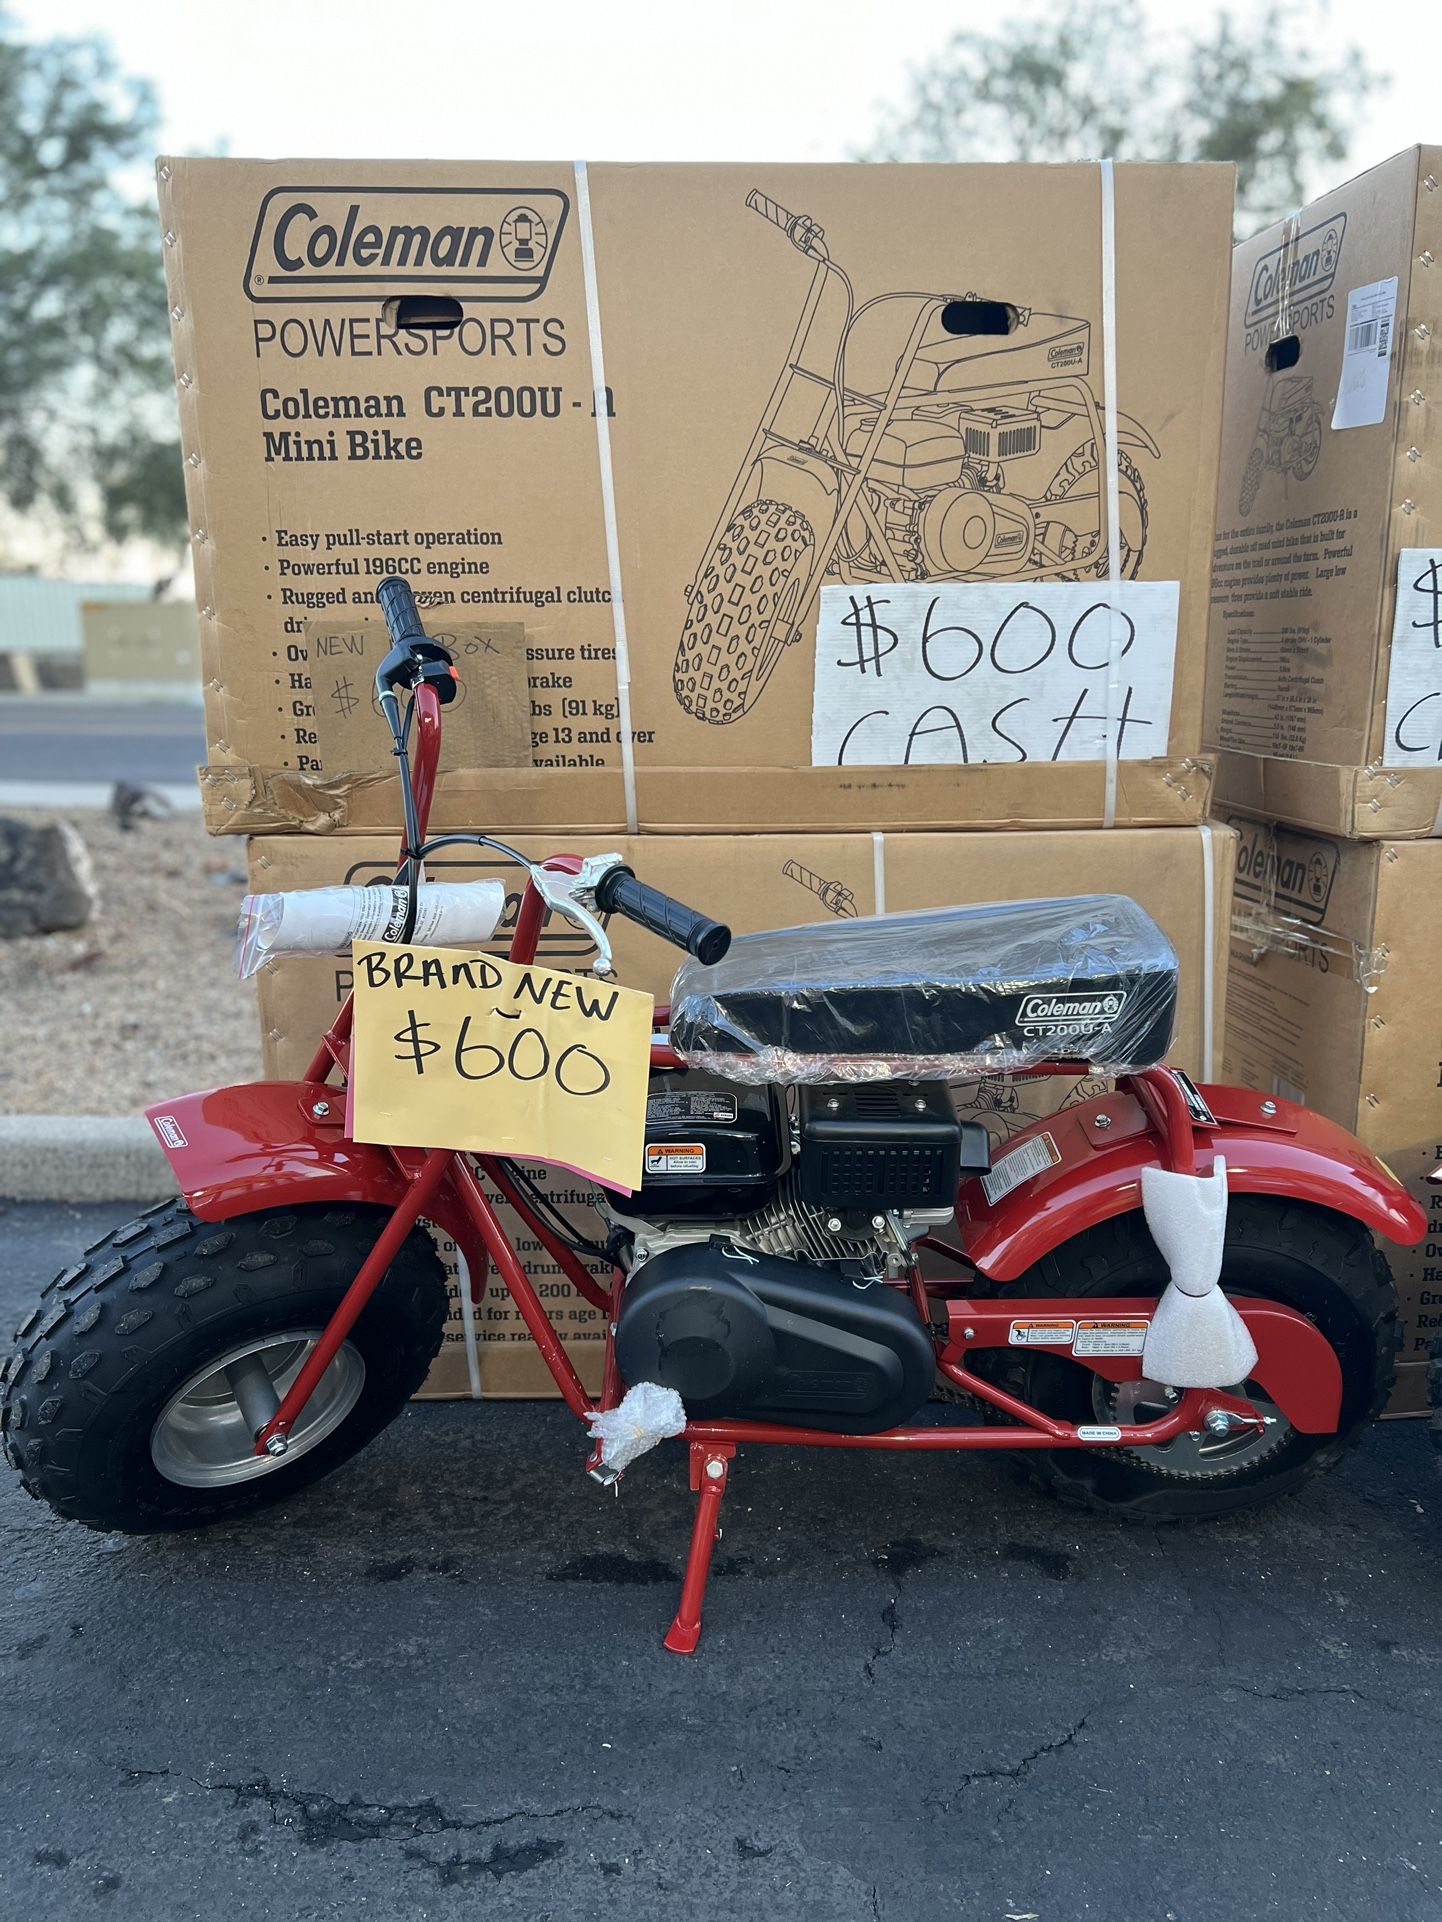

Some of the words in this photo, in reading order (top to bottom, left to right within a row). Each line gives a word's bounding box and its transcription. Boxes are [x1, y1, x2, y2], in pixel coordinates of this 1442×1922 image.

[273, 203, 494, 272] Coleman
[1254, 249, 1320, 306] Coleman
[1051, 346, 1077, 358] Coleman
[260, 387, 406, 420] Coleman
[423, 385, 563, 418] CT200U
[262, 430, 338, 462] Mini
[346, 429, 423, 461] Bike
[275, 529, 320, 550] Easy
[325, 528, 410, 550] pull-start
[414, 528, 503, 549] operation
[278, 557, 360, 576] Powerful
[364, 557, 421, 575] 196CC
[426, 557, 490, 578] engine
[281, 587, 347, 608] Rugged
[460, 586, 562, 607] centrifugal
[566, 586, 614, 604] clutc
[316, 635, 364, 658] NEW
[836, 595, 1136, 682] $600
[553, 727, 573, 744] 13
[577, 727, 611, 744] and
[837, 684, 1153, 766] CASH
[384, 898, 408, 942] Coleman
[357, 950, 503, 990] BRAND
[512, 971, 620, 1022] NEW
[1026, 998, 1102, 1018] Coleman
[1023, 1022, 1112, 1037] CT200U-A
[393, 1009, 612, 1096] $600
[539, 1284, 571, 1298] 200
[487, 1307, 510, 1321] for
[573, 1309, 597, 1323] age
